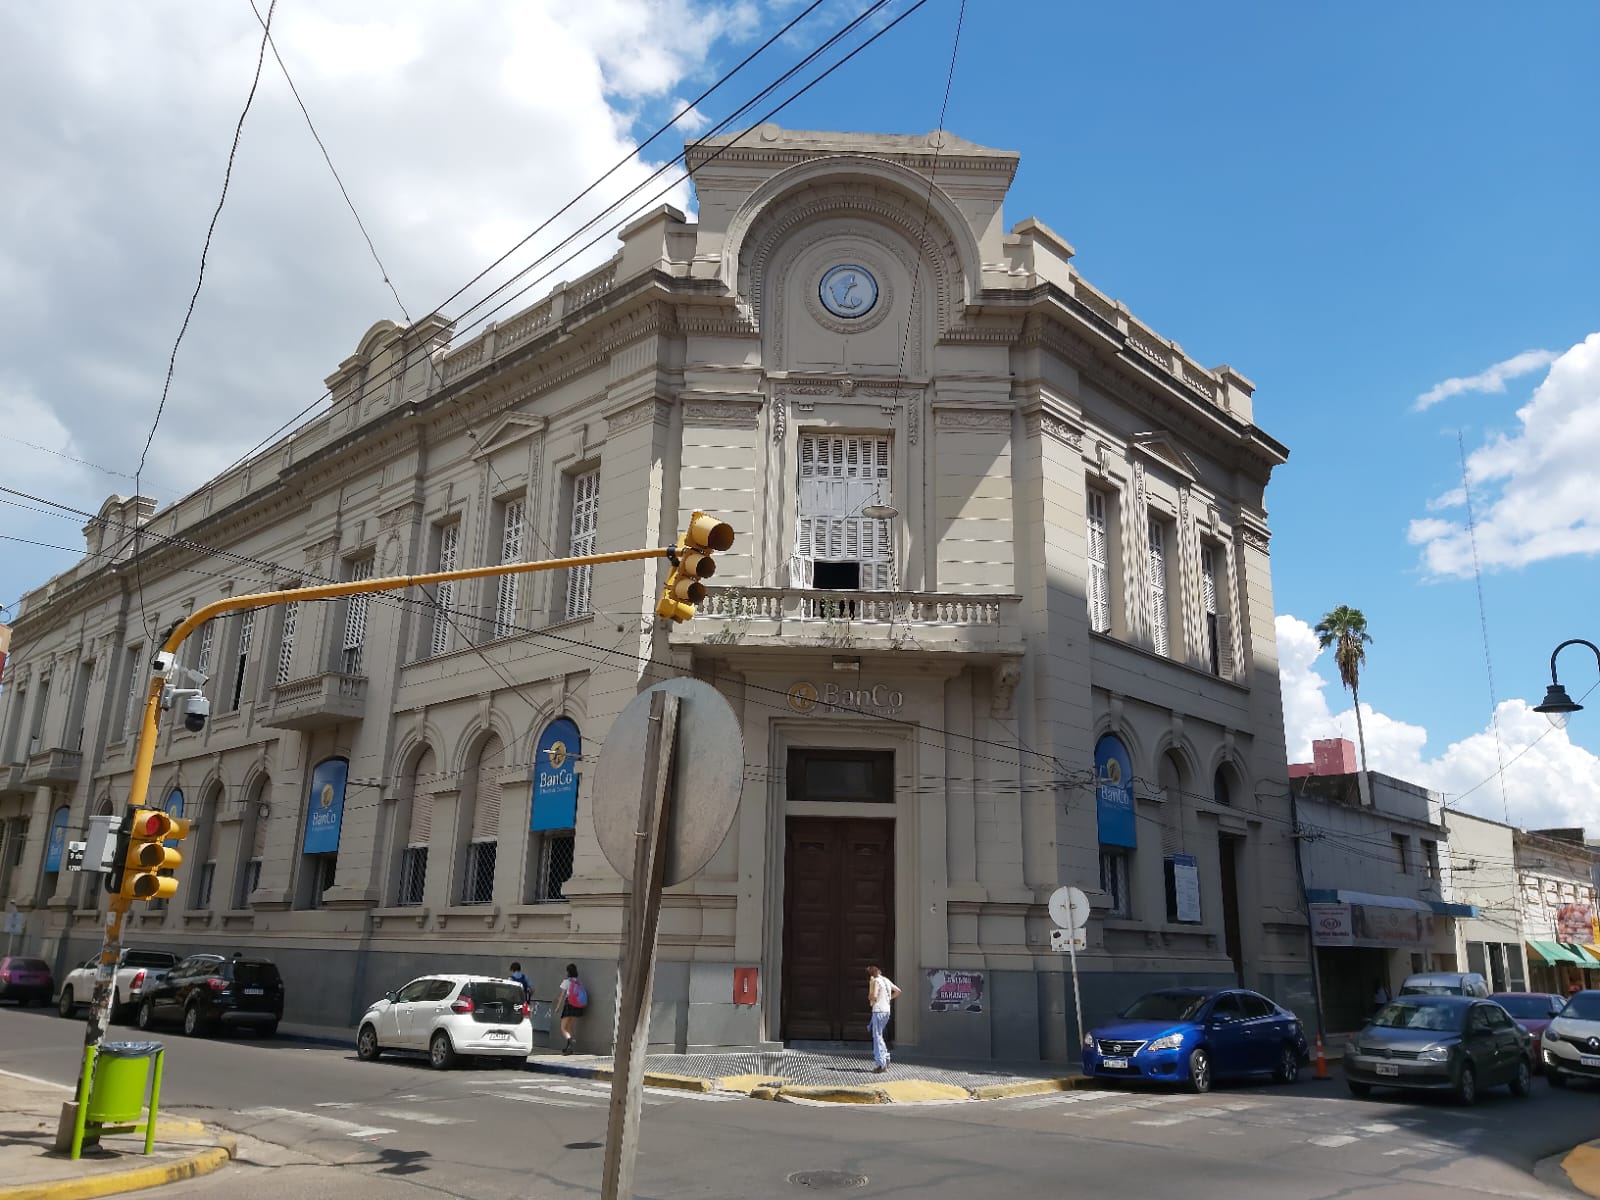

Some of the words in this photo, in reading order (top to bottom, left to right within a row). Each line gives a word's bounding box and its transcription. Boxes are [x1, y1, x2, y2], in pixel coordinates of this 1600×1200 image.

[823, 682, 904, 708] BanCo
[540, 769, 573, 788] BanCo
[1101, 784, 1129, 805] BanCo
[312, 809, 337, 827] BanCo
